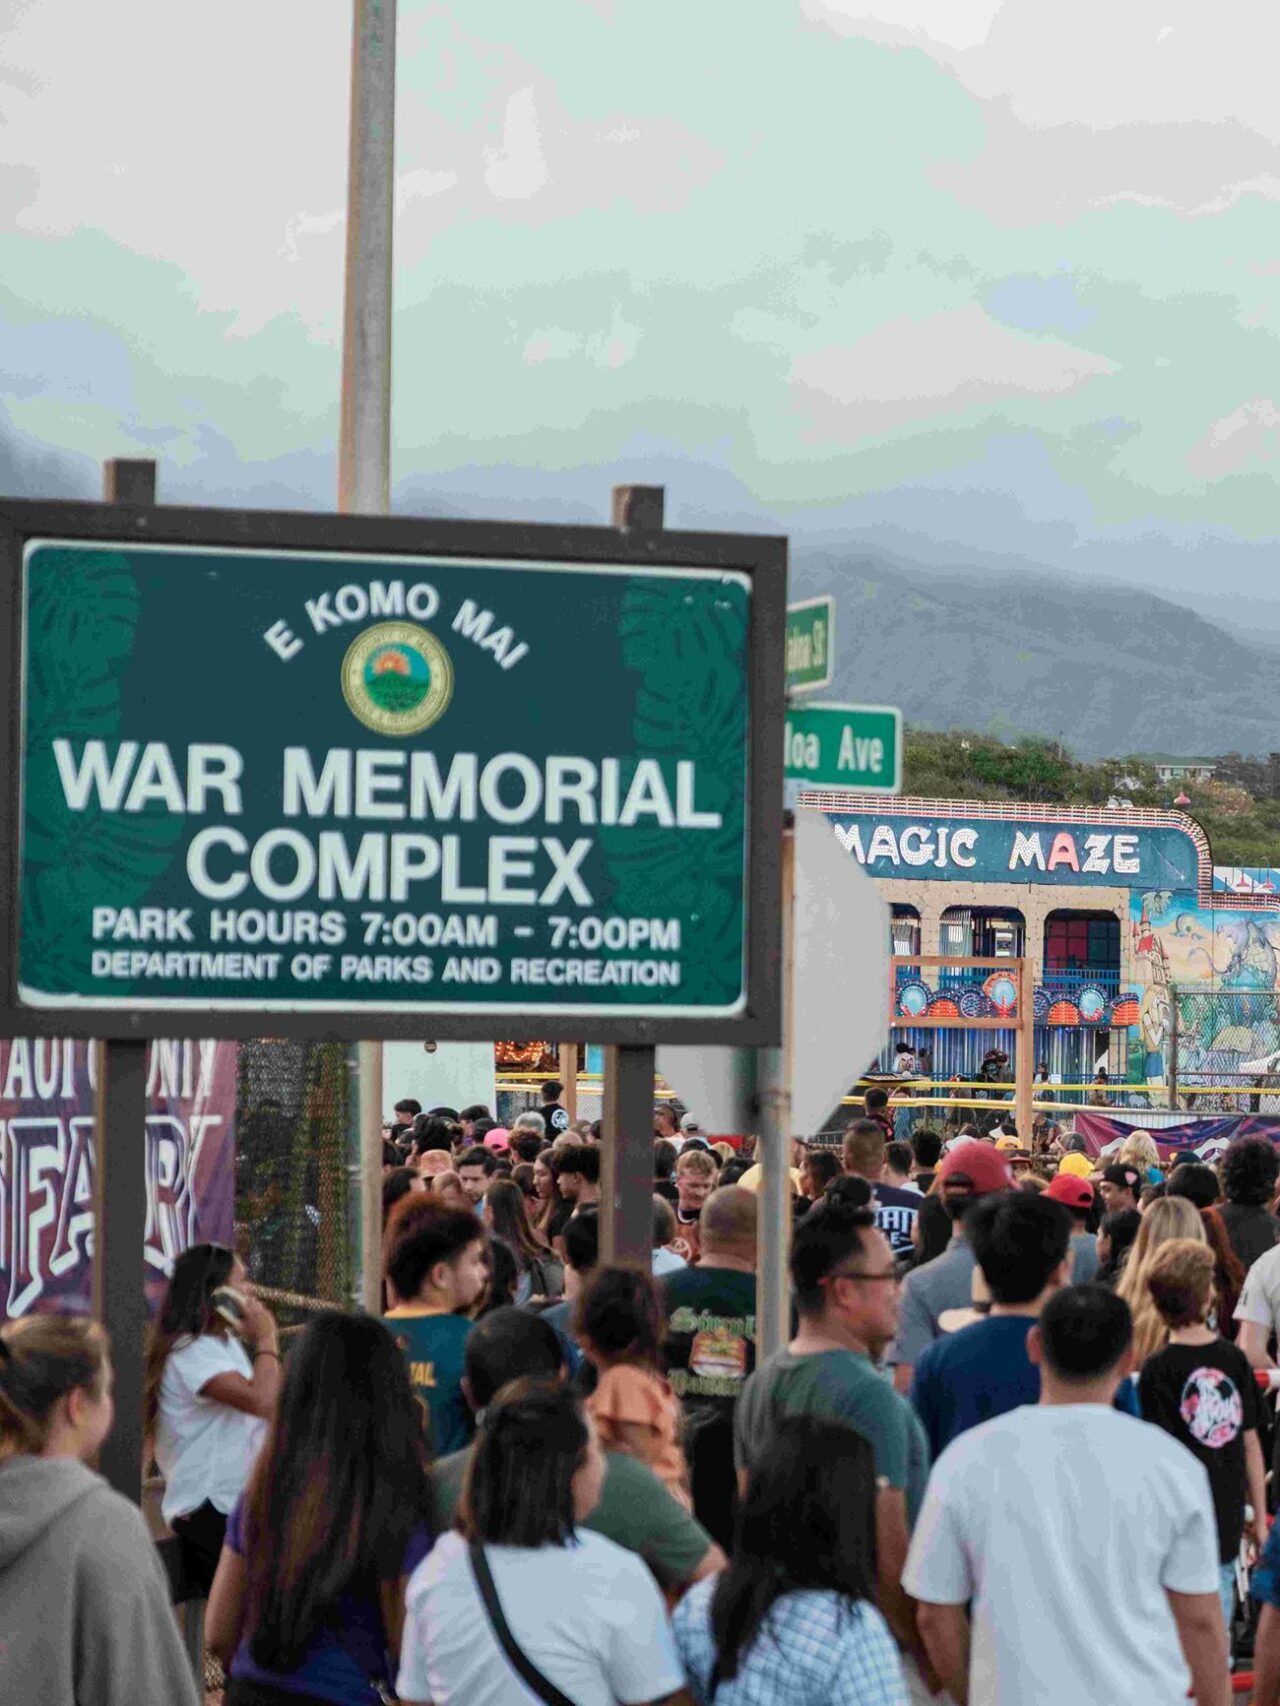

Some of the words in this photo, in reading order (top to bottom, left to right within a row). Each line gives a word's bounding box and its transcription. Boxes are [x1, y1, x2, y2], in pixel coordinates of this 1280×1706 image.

[263, 620, 303, 660] E
[305, 581, 439, 632] KOMO
[451, 599, 528, 669] MAI
[838, 725, 884, 773] Ave
[53, 739, 243, 814] WAR
[283, 747, 722, 829] MEMORIAL
[186, 826, 593, 906] COMPLEX
[834, 822, 979, 868] MAGIC
[1008, 831, 1140, 874] MAZE
[92, 908, 193, 940] PARK
[210, 909, 345, 944] HOURS
[361, 912, 498, 947] 7:00AM
[548, 916, 680, 950] 7:00PM
[92, 951, 280, 980] DEPARTMENT
[290, 954, 330, 980] OF
[341, 955, 432, 982] PARKS
[442, 957, 501, 983] AND
[510, 958, 680, 986] RECREATION
